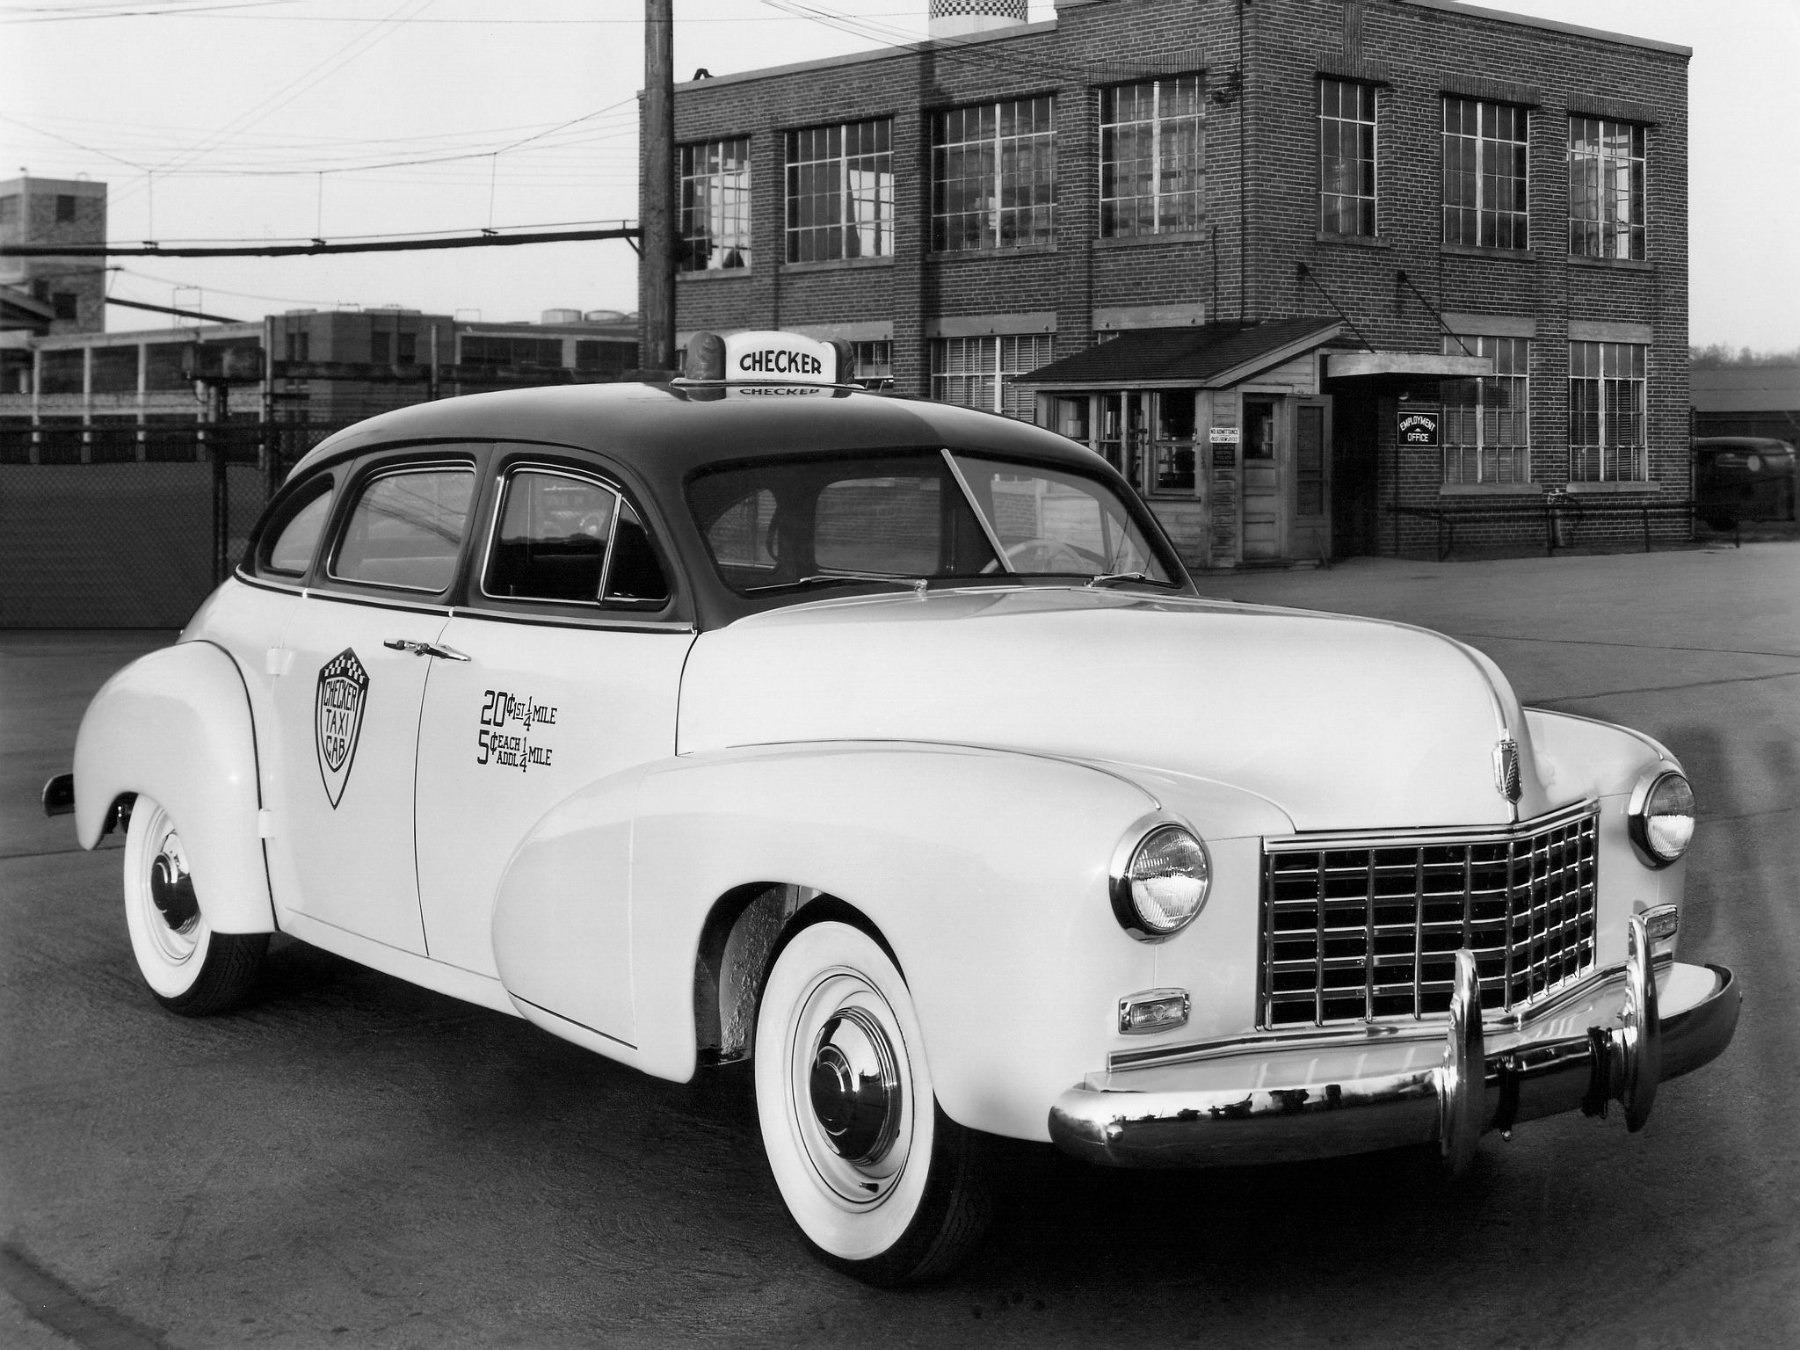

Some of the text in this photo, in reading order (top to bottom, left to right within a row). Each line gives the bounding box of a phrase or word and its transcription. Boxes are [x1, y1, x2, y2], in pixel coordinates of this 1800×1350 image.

[739, 350, 822, 375] CHECKER
[1399, 415, 1436, 431] EMPLOYMENT
[1407, 432, 1429, 442] OFFICE
[323, 679, 358, 712] CHECKER
[326, 708, 350, 737] TAXI
[532, 704, 558, 725] MILE
[325, 735, 346, 765] CAB
[497, 734, 521, 752] EACH
[496, 750, 519, 767] ADDL
[527, 745, 553, 767] MILE
